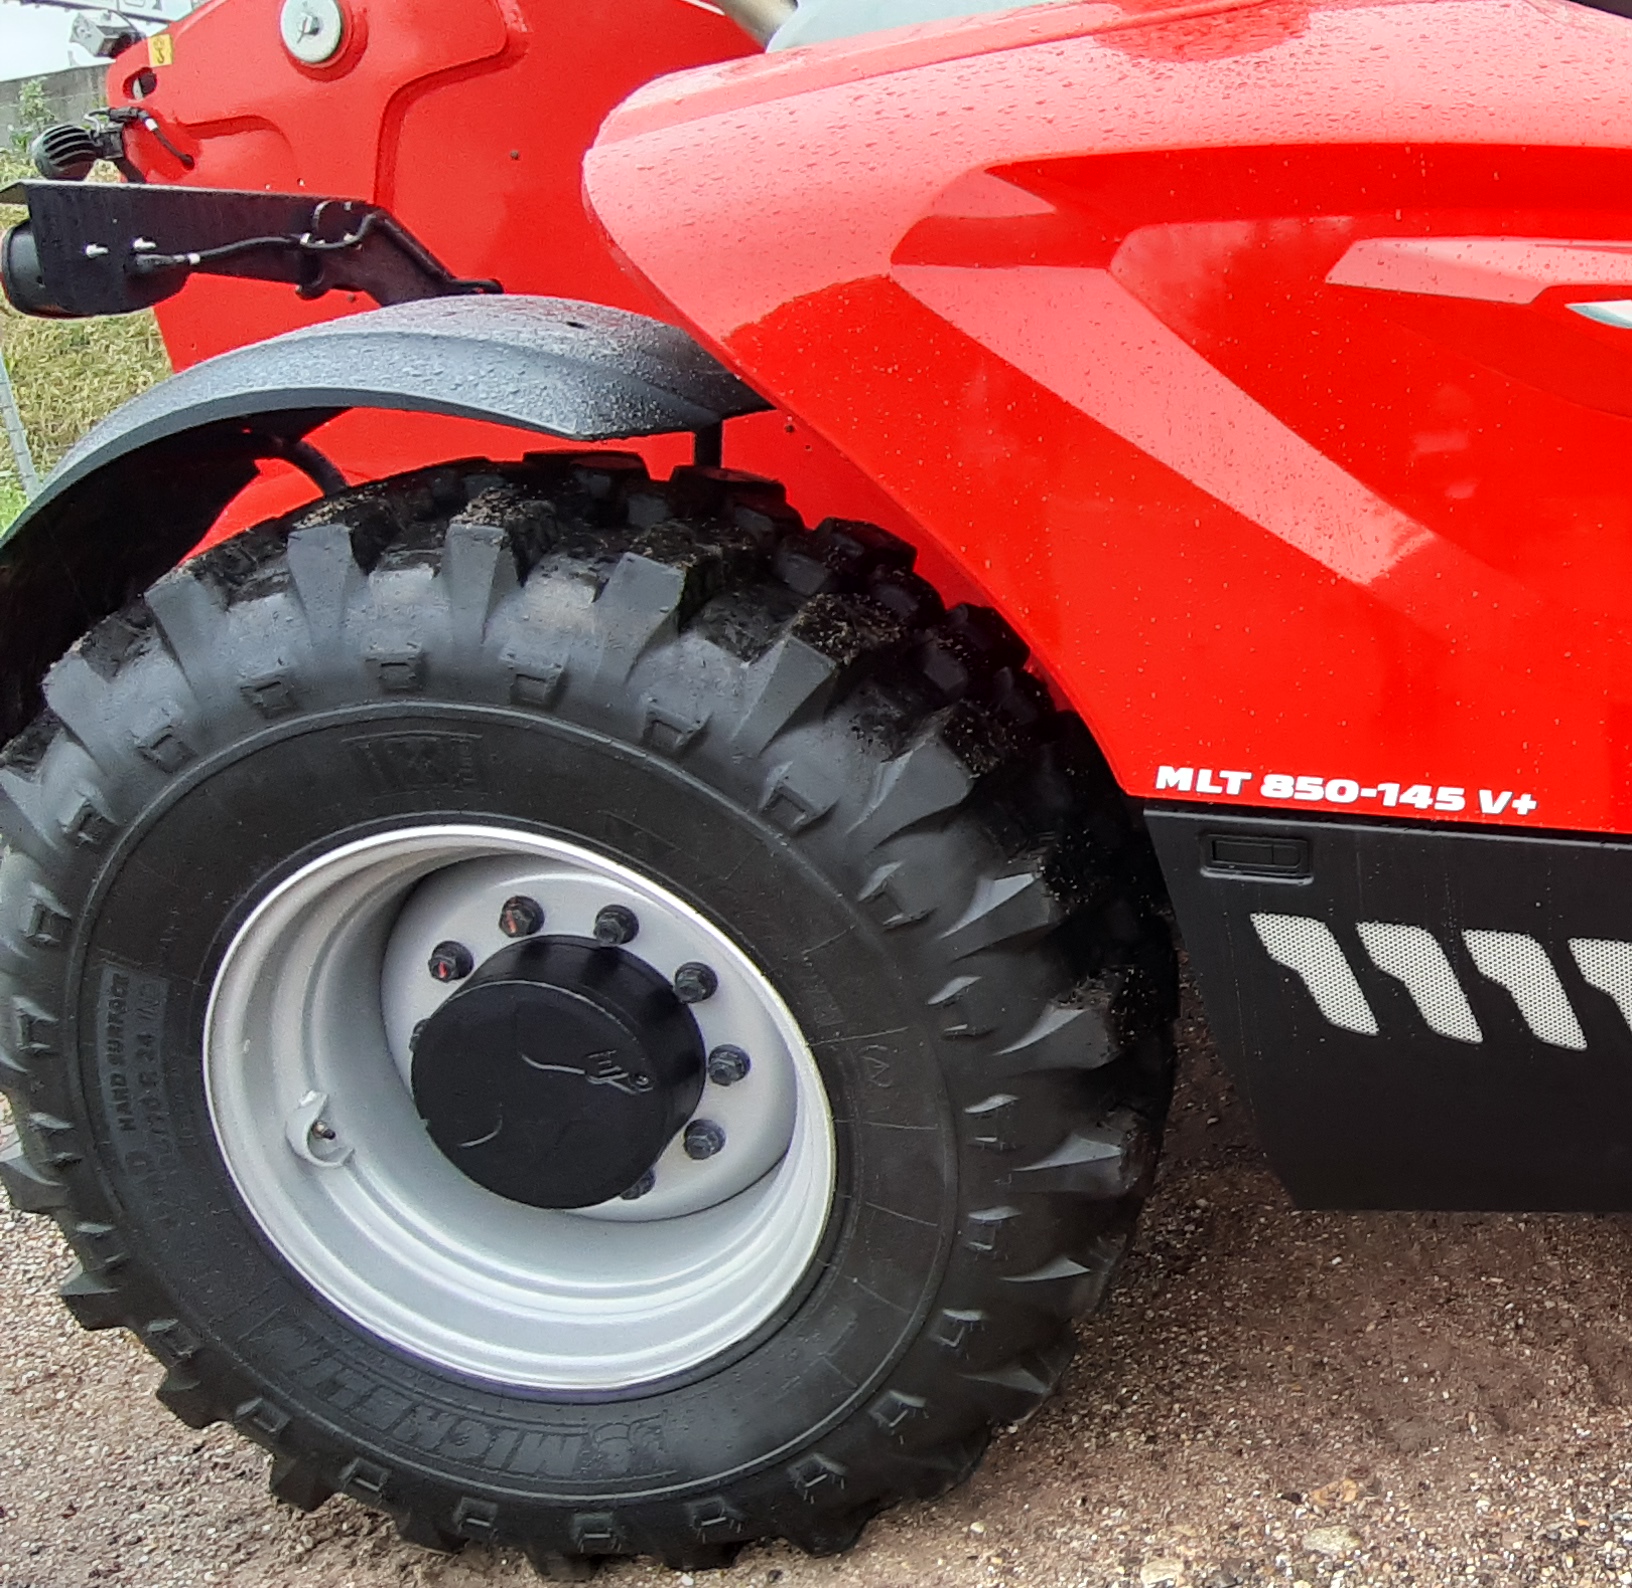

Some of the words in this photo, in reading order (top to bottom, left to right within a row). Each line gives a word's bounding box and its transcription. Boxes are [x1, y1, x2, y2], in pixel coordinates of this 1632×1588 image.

[1155, 765, 1253, 796] MLT
[1260, 773, 1467, 812] 850-145
[1478, 789, 1538, 816] V+
[106, 972, 130, 1066] SURFACE
[110, 1073, 137, 1132] HARD
[250, 1326, 581, 1476] MICHELIN
